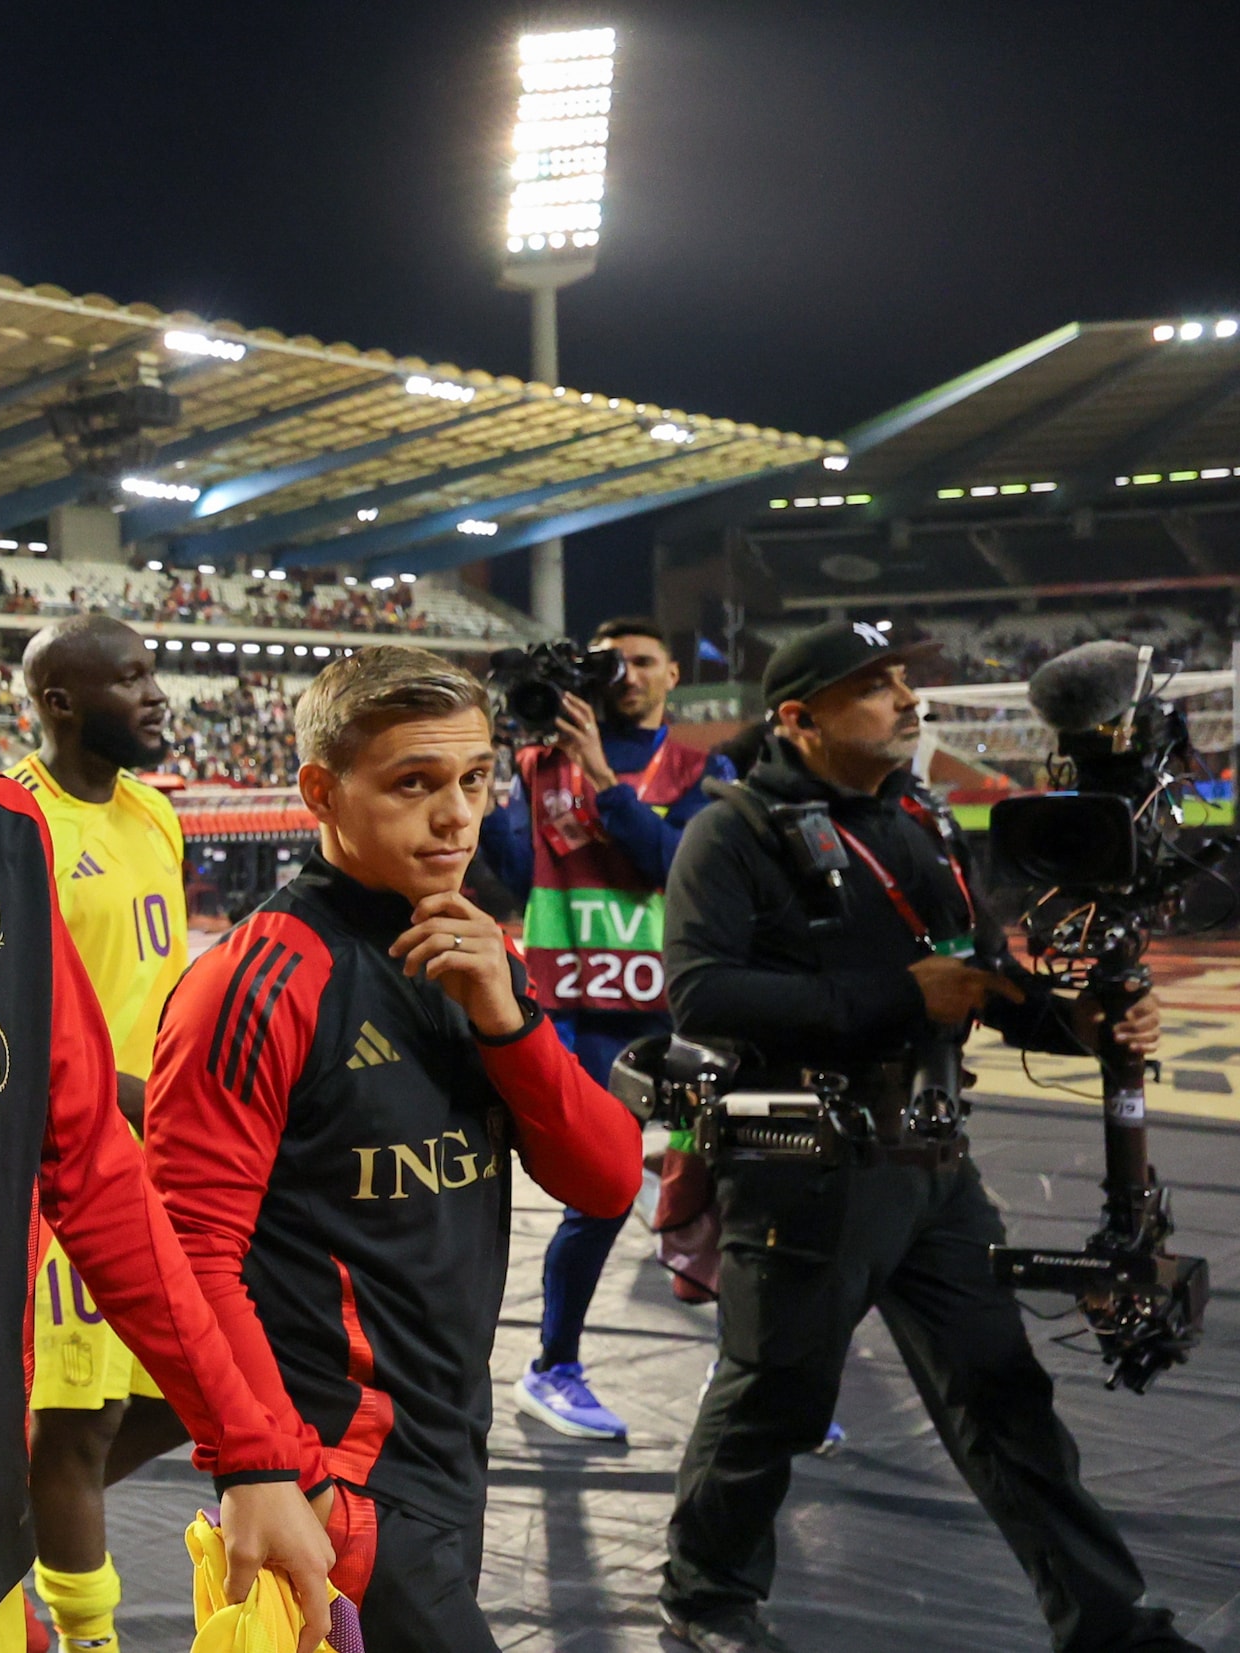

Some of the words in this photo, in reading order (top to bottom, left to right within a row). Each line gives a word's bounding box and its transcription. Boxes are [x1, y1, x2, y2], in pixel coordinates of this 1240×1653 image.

[133, 894, 171, 962] 10
[570, 900, 647, 943] TV
[555, 953, 665, 1002] 220
[350, 1129, 478, 1199] ING
